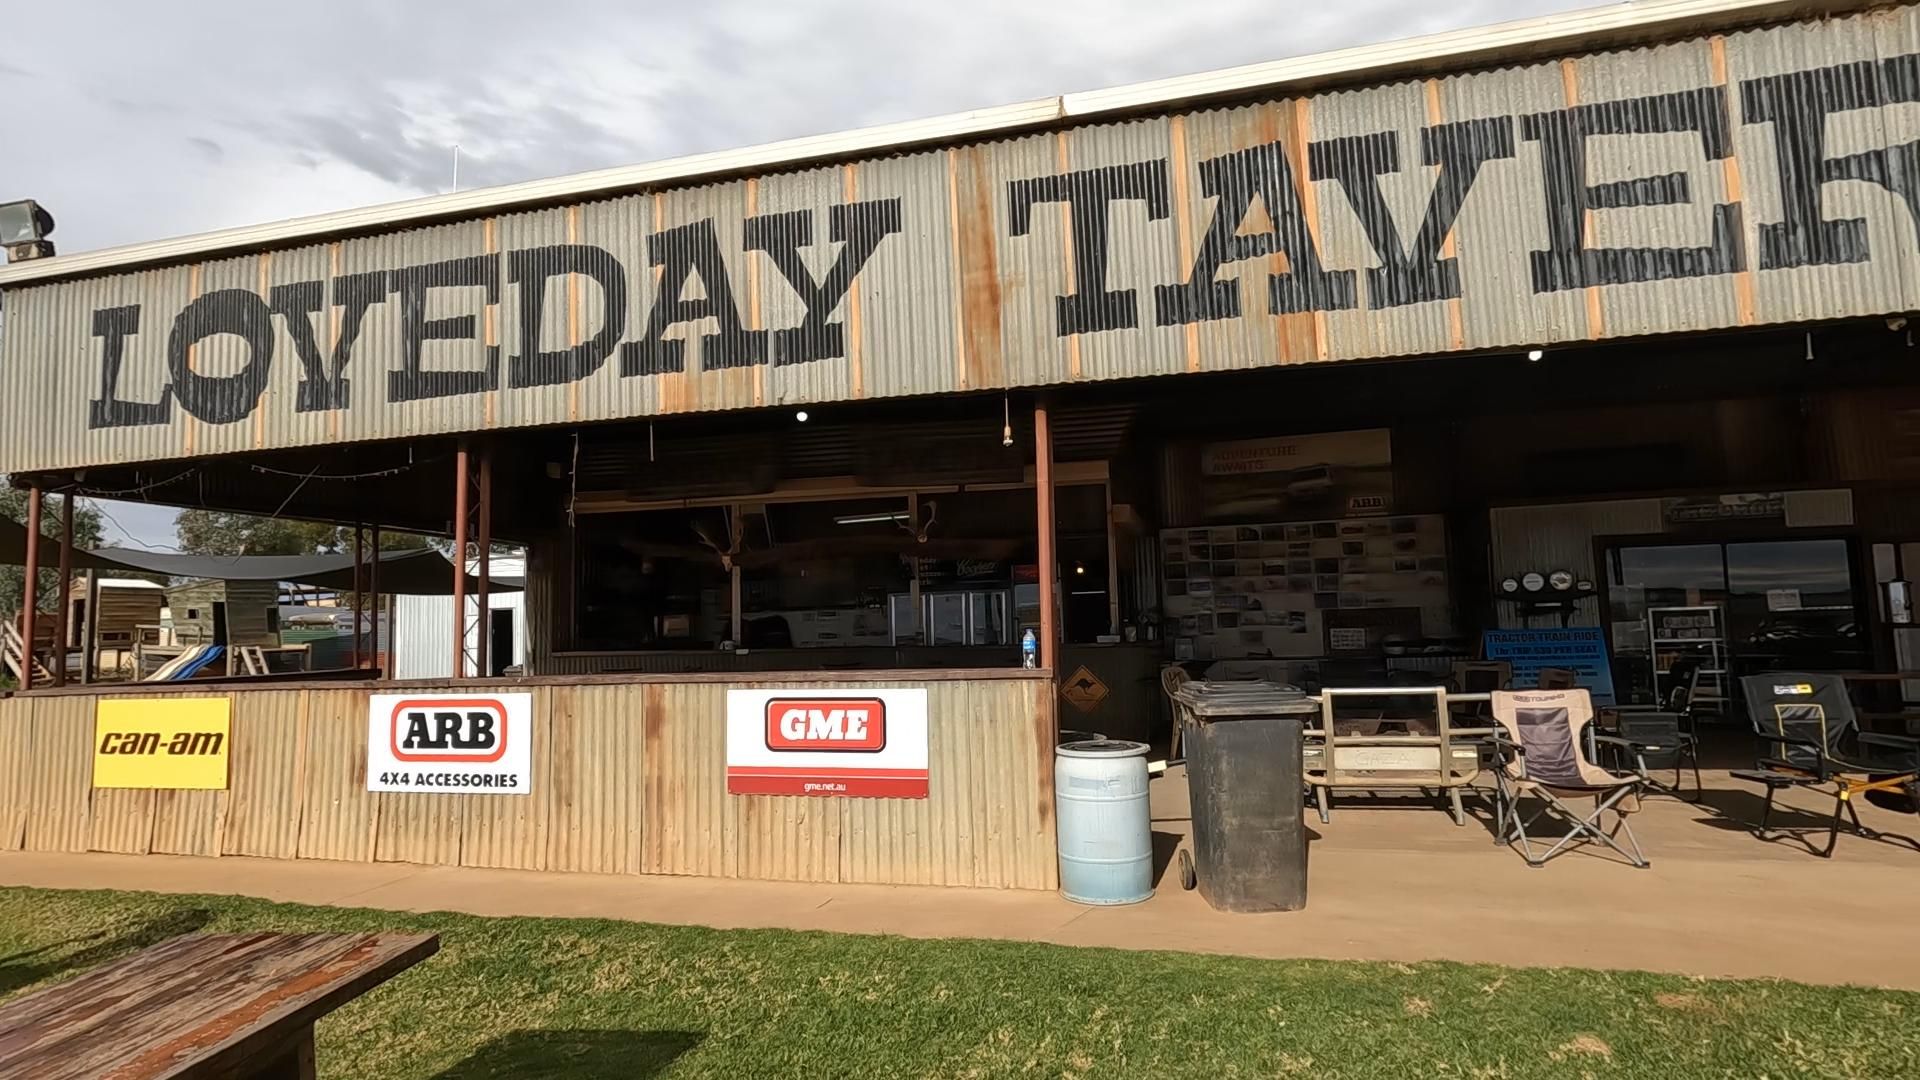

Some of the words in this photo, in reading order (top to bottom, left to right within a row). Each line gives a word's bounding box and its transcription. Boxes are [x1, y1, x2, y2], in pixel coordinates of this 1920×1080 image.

[88, 197, 901, 430] LOVEDAY
[1212, 462, 1265, 473] AWAITS
[1352, 497, 1381, 508] ARB
[1488, 633, 1536, 643] TRACTOR
[1538, 632, 1571, 642] TRAIN
[1574, 632, 1600, 641] RIDE
[1575, 645, 1598, 653] SEAT
[403, 712, 495, 749] ARB
[780, 709, 868, 741] GME
[99, 731, 223, 755] can-am
[415, 773, 518, 788] ACCESSORIES
[804, 783, 846, 793] gme.net.au
